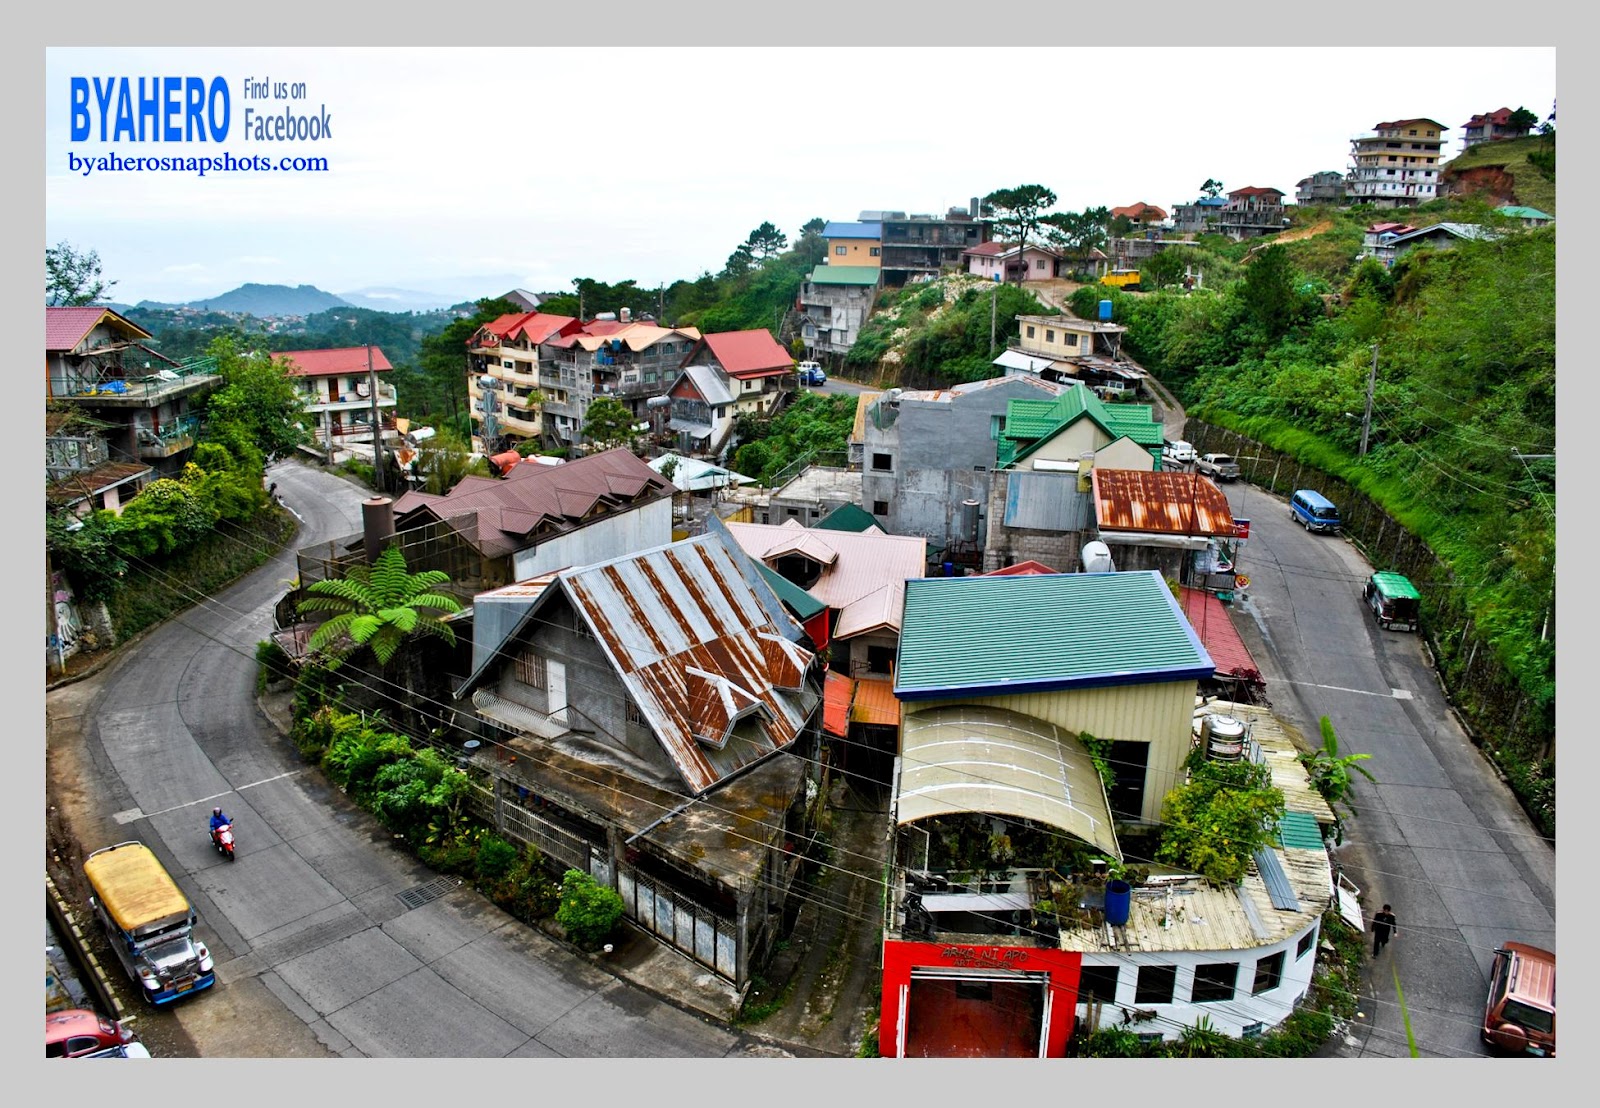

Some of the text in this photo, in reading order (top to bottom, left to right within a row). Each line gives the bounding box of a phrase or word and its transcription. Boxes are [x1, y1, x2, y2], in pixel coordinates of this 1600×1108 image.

[941, 947, 1028, 961] ARKO NI APO
